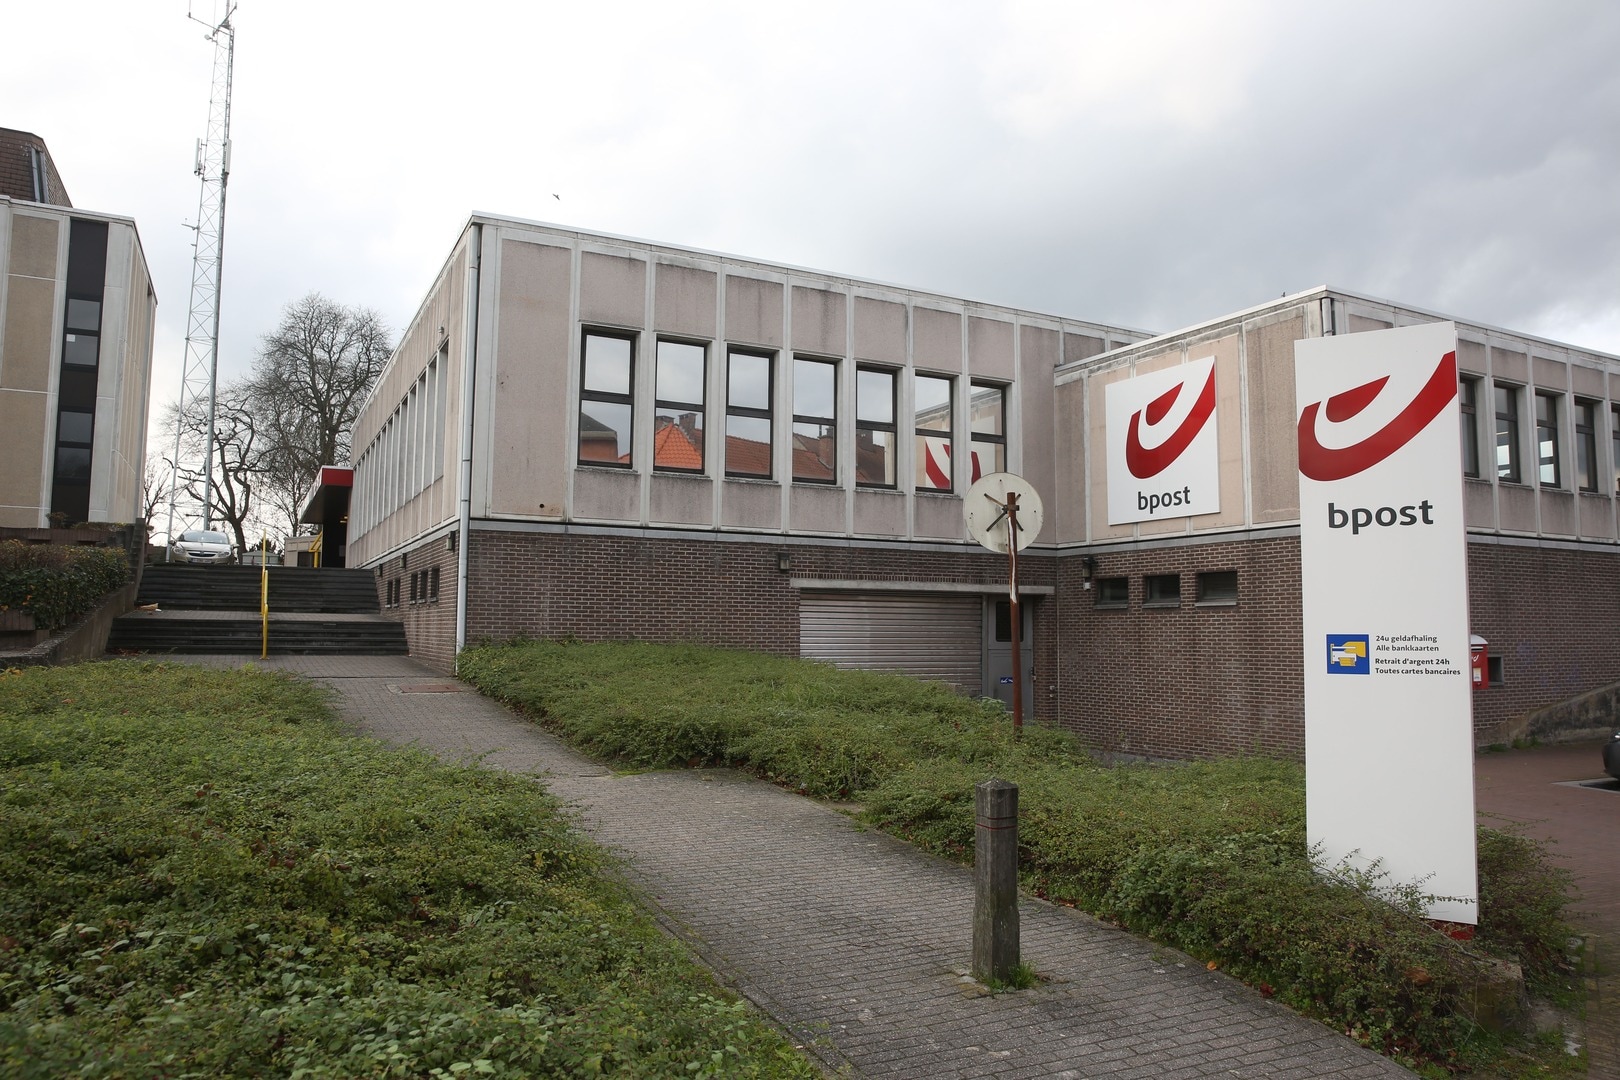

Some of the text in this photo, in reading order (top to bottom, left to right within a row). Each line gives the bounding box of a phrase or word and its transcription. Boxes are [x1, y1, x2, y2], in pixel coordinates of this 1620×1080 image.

[1138, 486, 1190, 514] bpost
[1328, 500, 1433, 535] bpost
[1390, 634, 1438, 643] geldafhaling
[1402, 658, 1434, 666] d'argent
